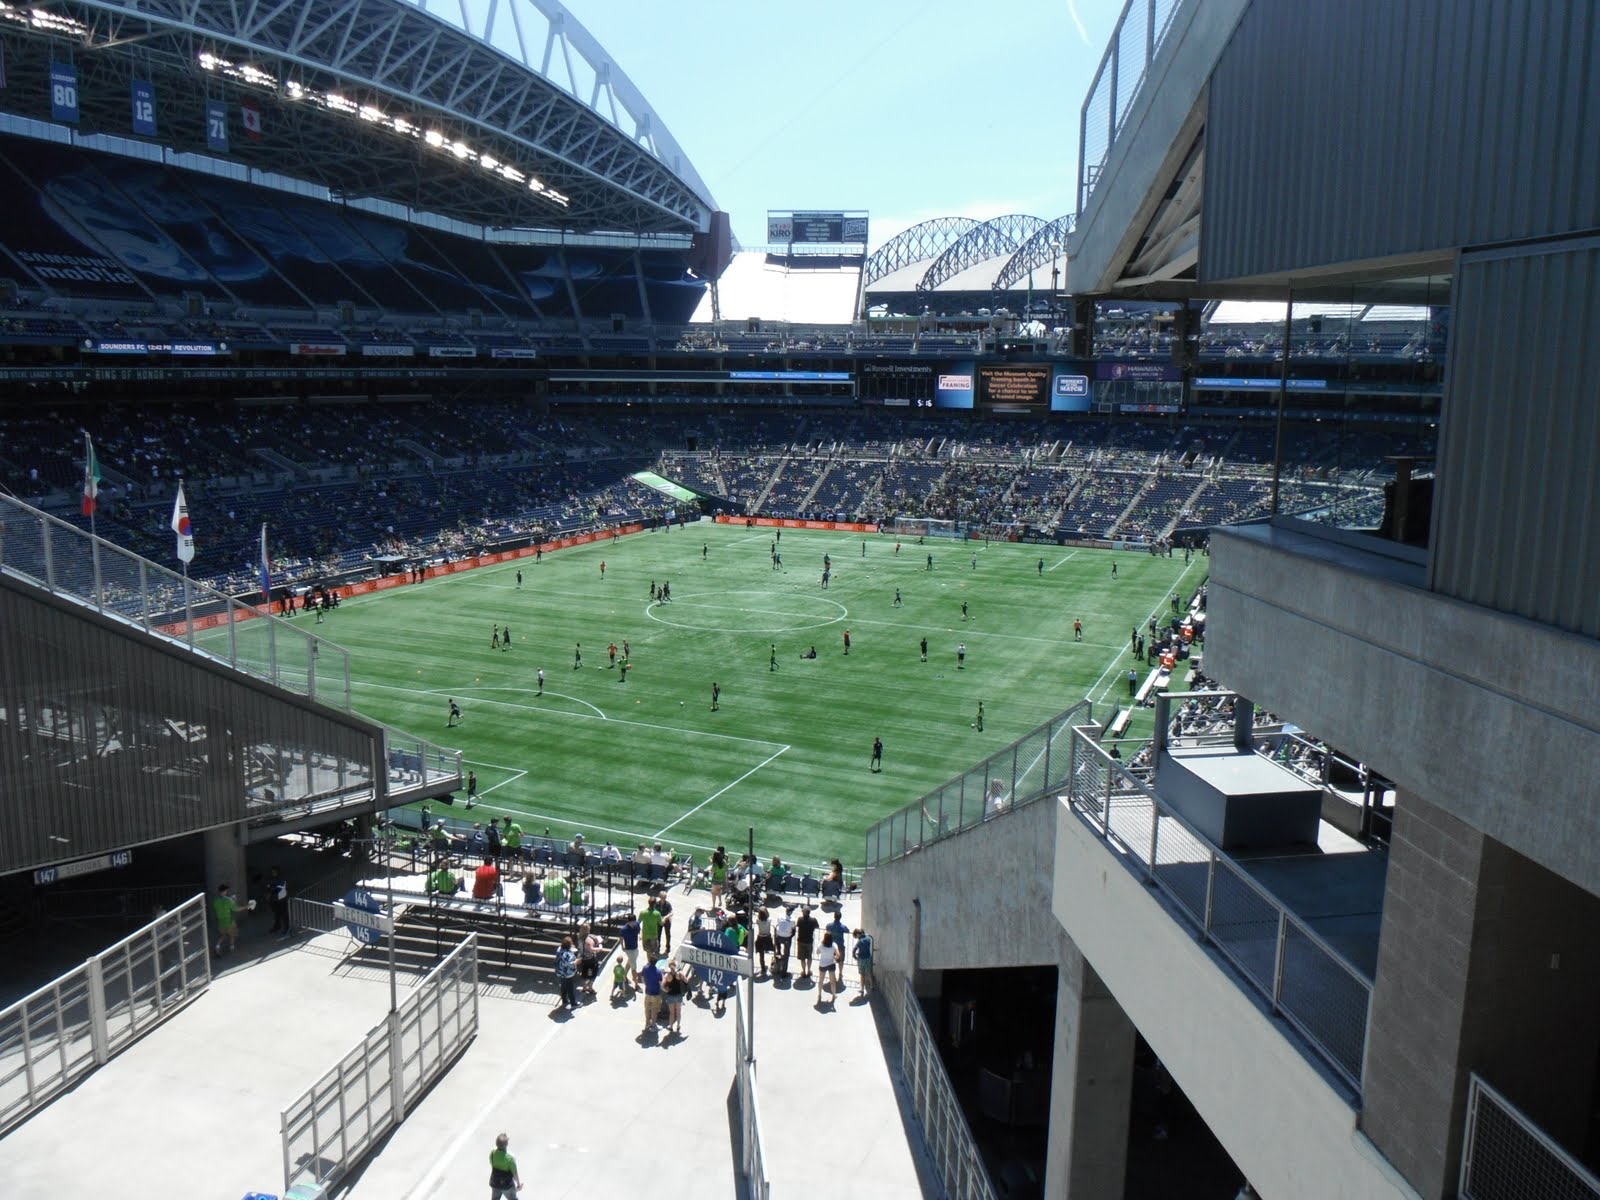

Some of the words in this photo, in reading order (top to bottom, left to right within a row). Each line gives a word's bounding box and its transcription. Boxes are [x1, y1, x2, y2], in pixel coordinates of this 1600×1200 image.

[54, 84, 76, 108] 80
[136, 101, 153, 122] 12
[209, 119, 225, 139] 71
[770, 229, 790, 237] KIRO
[18, 251, 118, 268] SAMSUNG
[33, 266, 135, 284] mobile
[772, 511, 816, 521] GORILLA
[820, 512, 834, 522] FC
[40, 869, 55, 883] 147
[112, 852, 128, 867] 146
[354, 891, 368, 908] 144
[341, 907, 381, 929] SECTIONS
[356, 926, 370, 942] 145
[707, 931, 722, 949] 144
[689, 949, 739, 971] SECTIONS
[708, 968, 724, 986] 142
